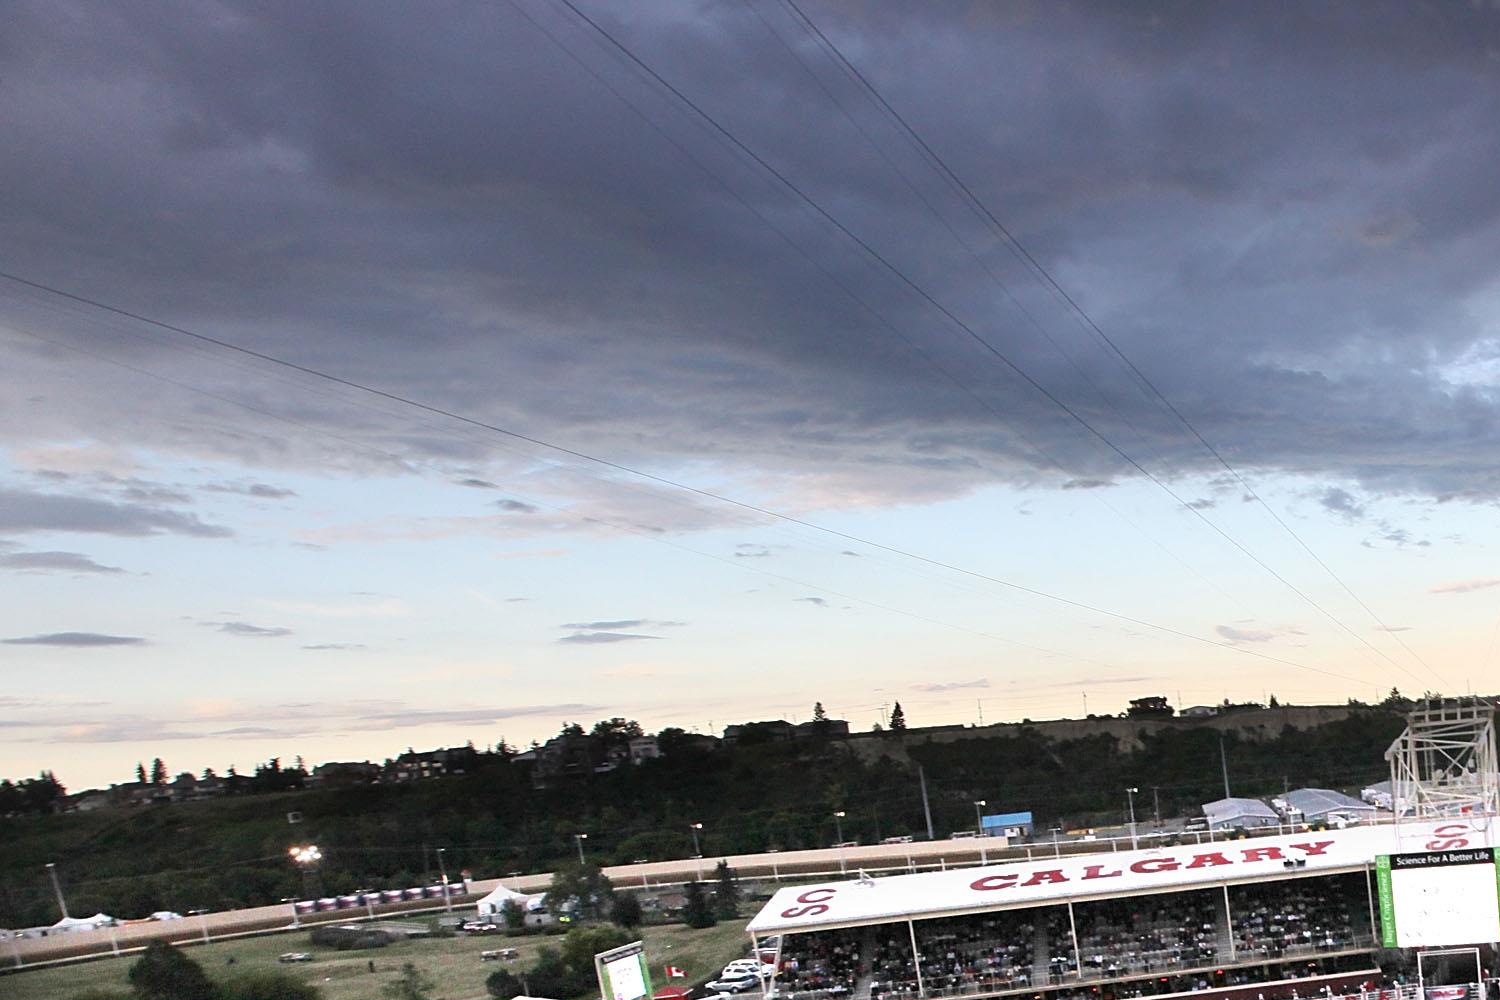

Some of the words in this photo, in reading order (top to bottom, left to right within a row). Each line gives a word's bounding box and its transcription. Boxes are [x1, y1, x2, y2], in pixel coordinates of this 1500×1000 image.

[970, 840, 1334, 891] CALGARY
[1396, 857, 1426, 866] Science
[1427, 855, 1440, 863] For
[1449, 853, 1473, 862] Better
[1474, 851, 1489, 860] Life
[1385, 922, 1393, 943] Bayer
